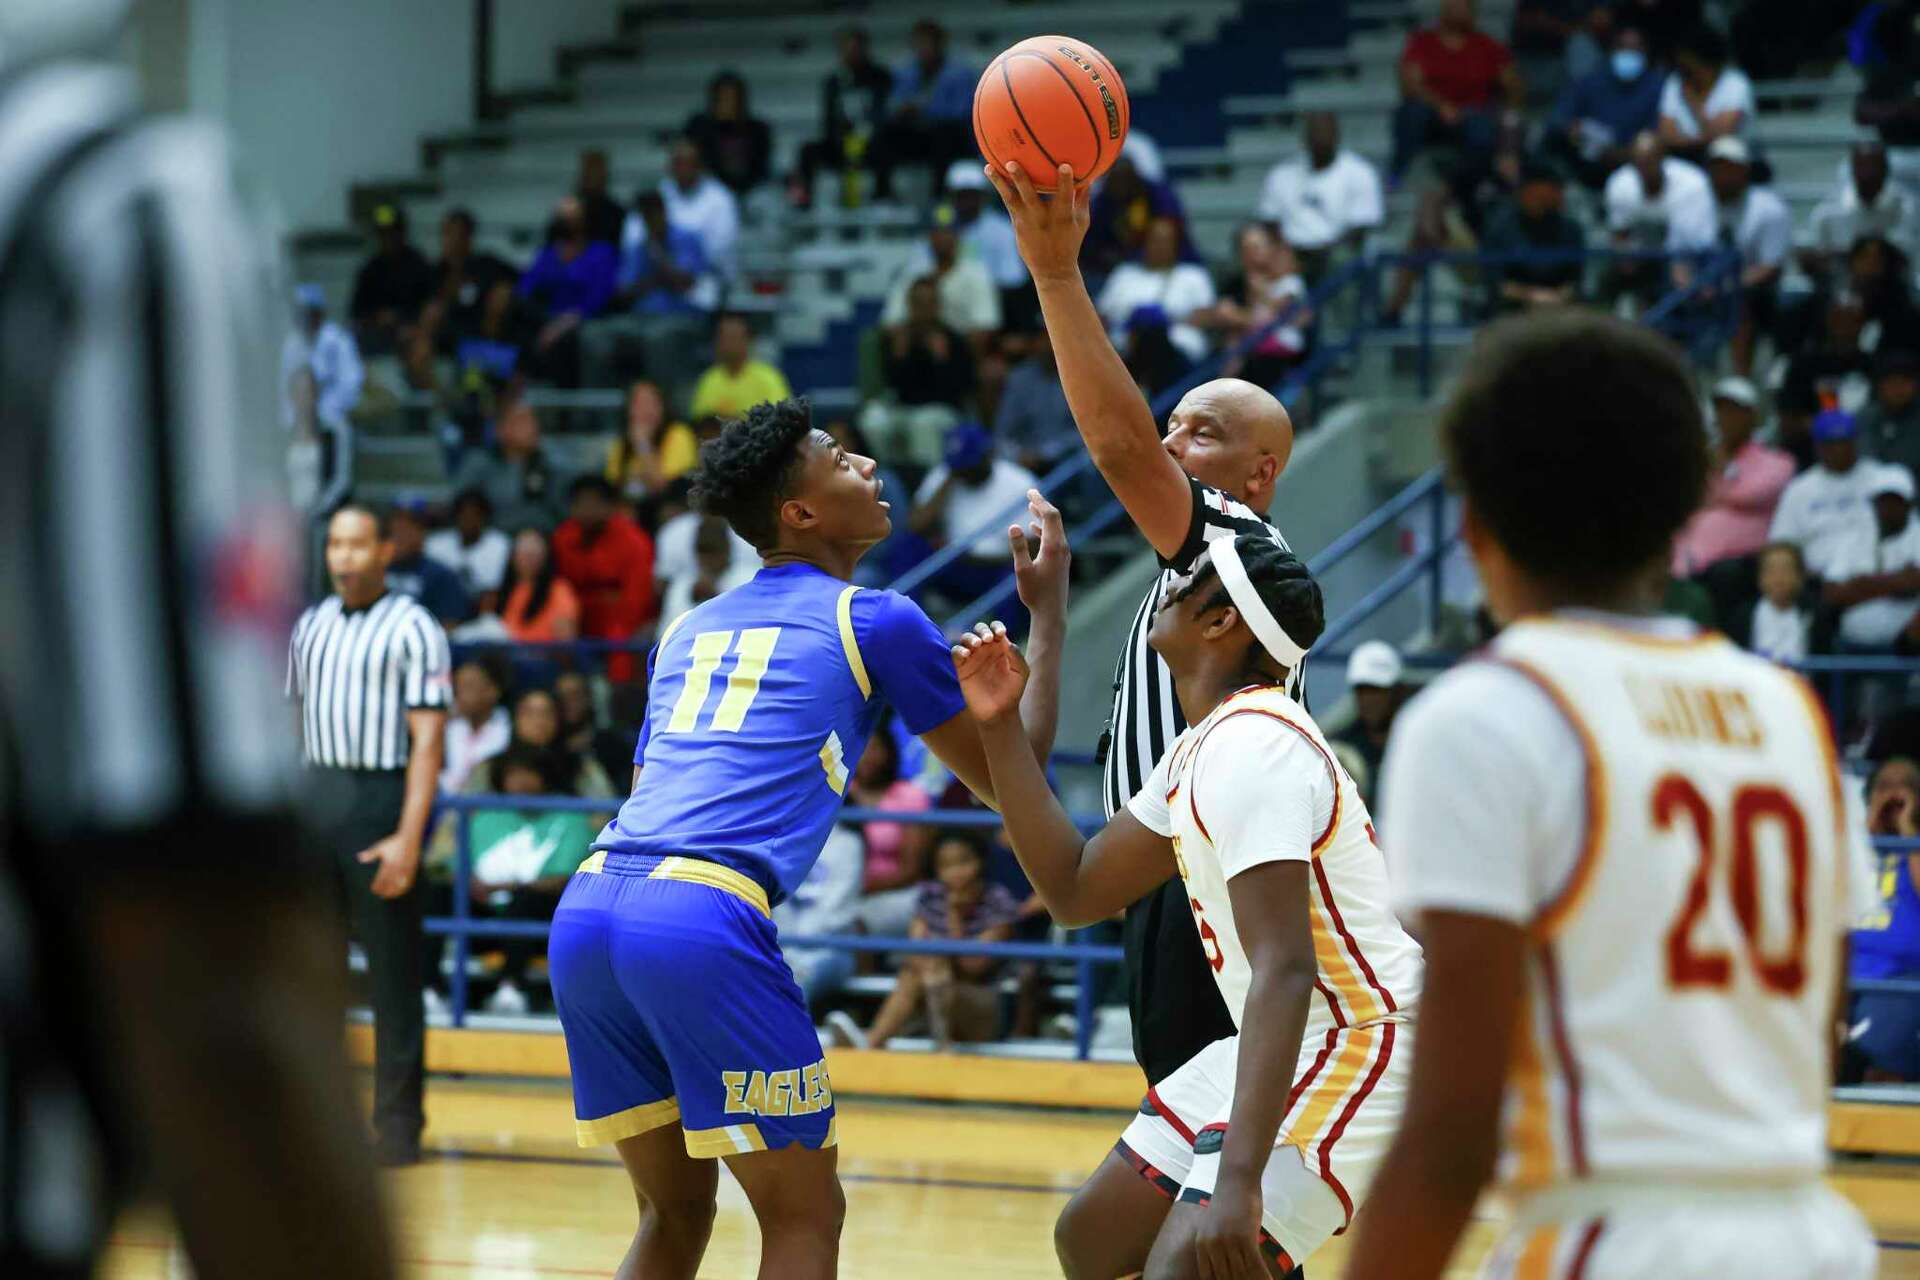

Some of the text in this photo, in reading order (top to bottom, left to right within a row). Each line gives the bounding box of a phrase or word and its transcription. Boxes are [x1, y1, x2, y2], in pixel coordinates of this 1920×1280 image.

[1057, 46, 1111, 105] ELITE
[664, 627, 781, 733] 11
[1650, 769, 1808, 1000] 20
[722, 1058, 832, 1116] EAGLES
